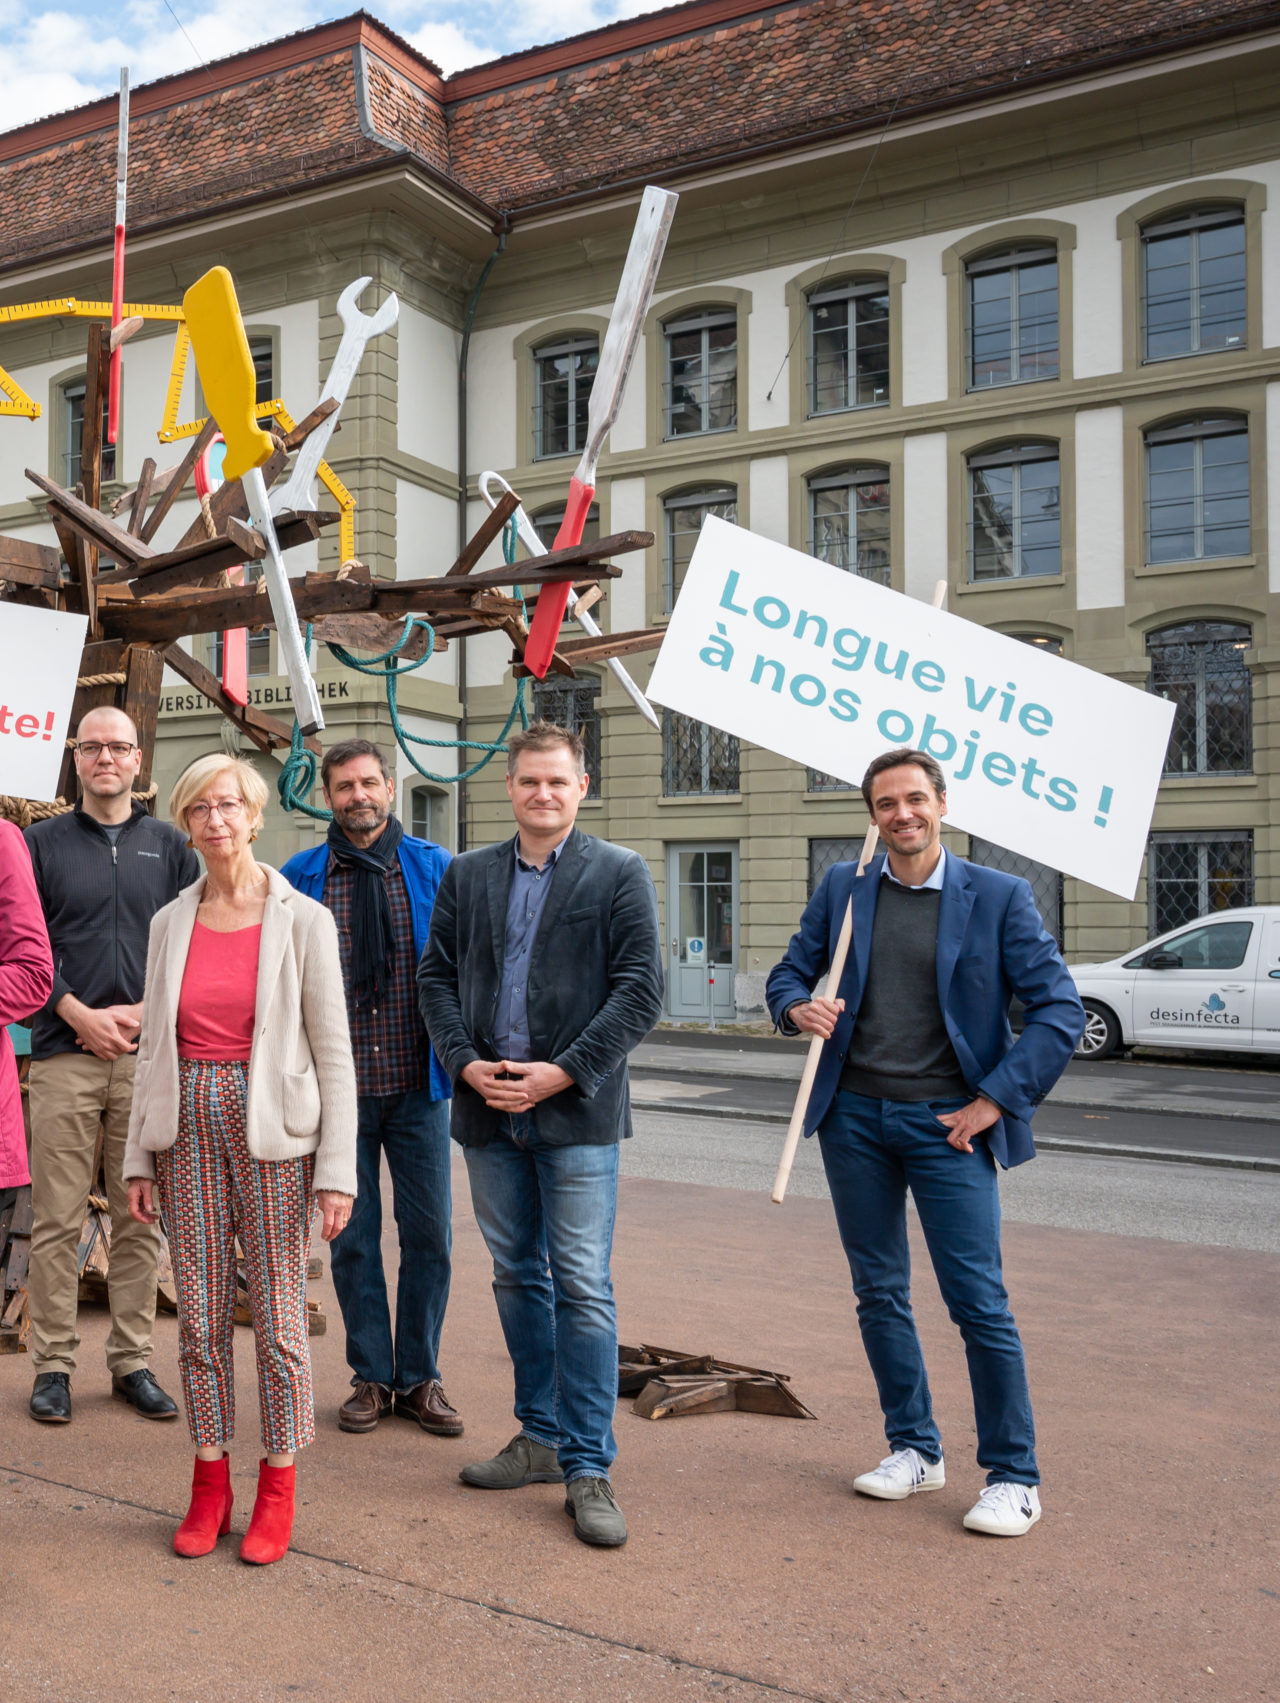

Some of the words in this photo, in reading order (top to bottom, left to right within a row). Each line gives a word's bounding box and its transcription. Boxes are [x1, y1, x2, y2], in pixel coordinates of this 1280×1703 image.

[699, 623, 735, 671] à
[751, 655, 862, 722] nos
[877, 710, 1078, 811] objets
[1094, 786, 1114, 828] !
[720, 570, 946, 692] Longue
[965, 677, 1053, 737] vie
[1150, 1008, 1240, 1024] desinfecta
